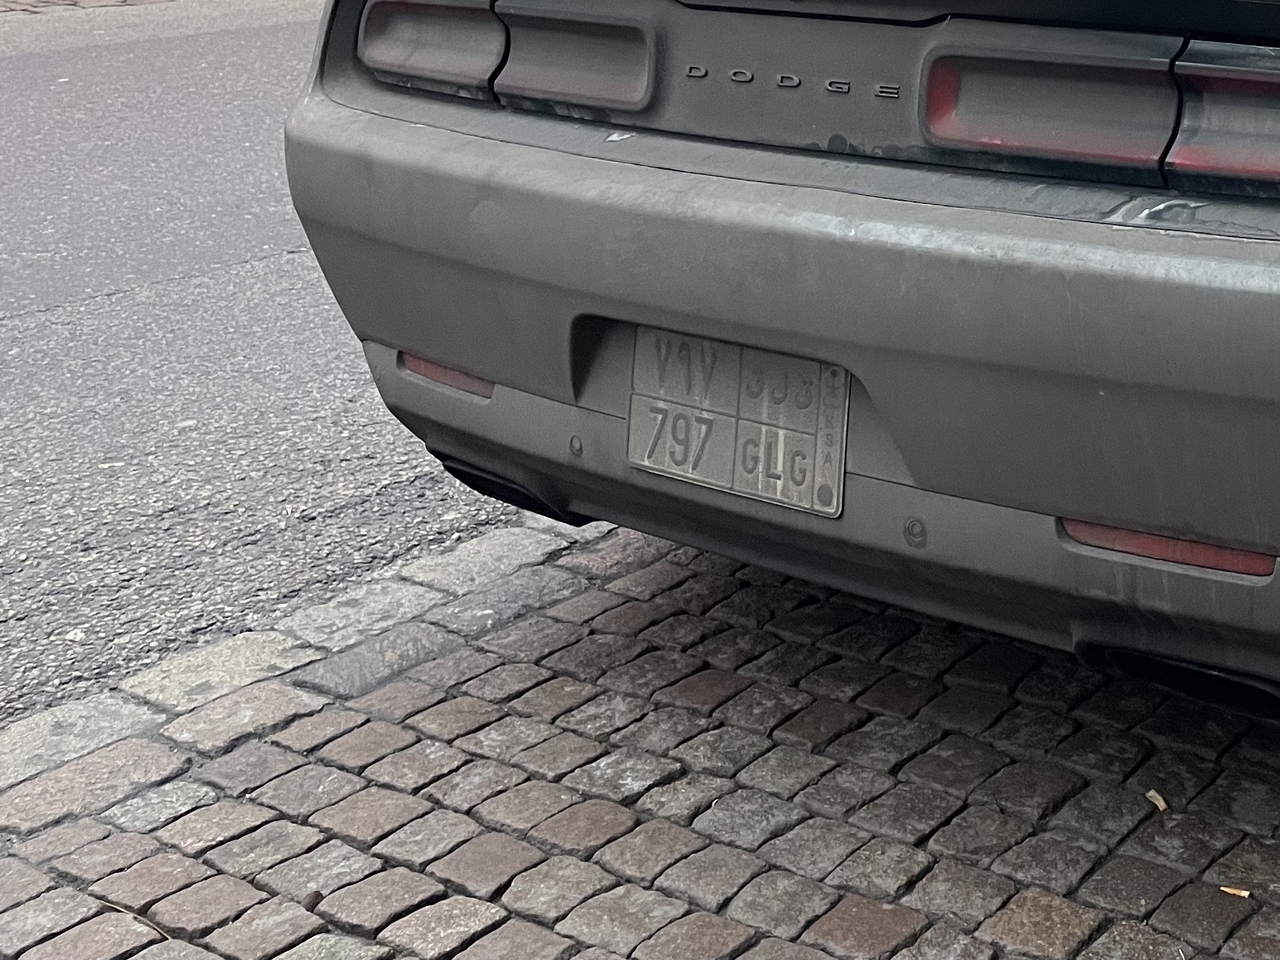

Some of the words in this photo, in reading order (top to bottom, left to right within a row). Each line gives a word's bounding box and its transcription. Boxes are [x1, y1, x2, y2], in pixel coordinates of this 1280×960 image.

[685, 65, 901, 99] DODGE
[645, 405, 714, 474] 797
[740, 437, 807, 487] GLG
